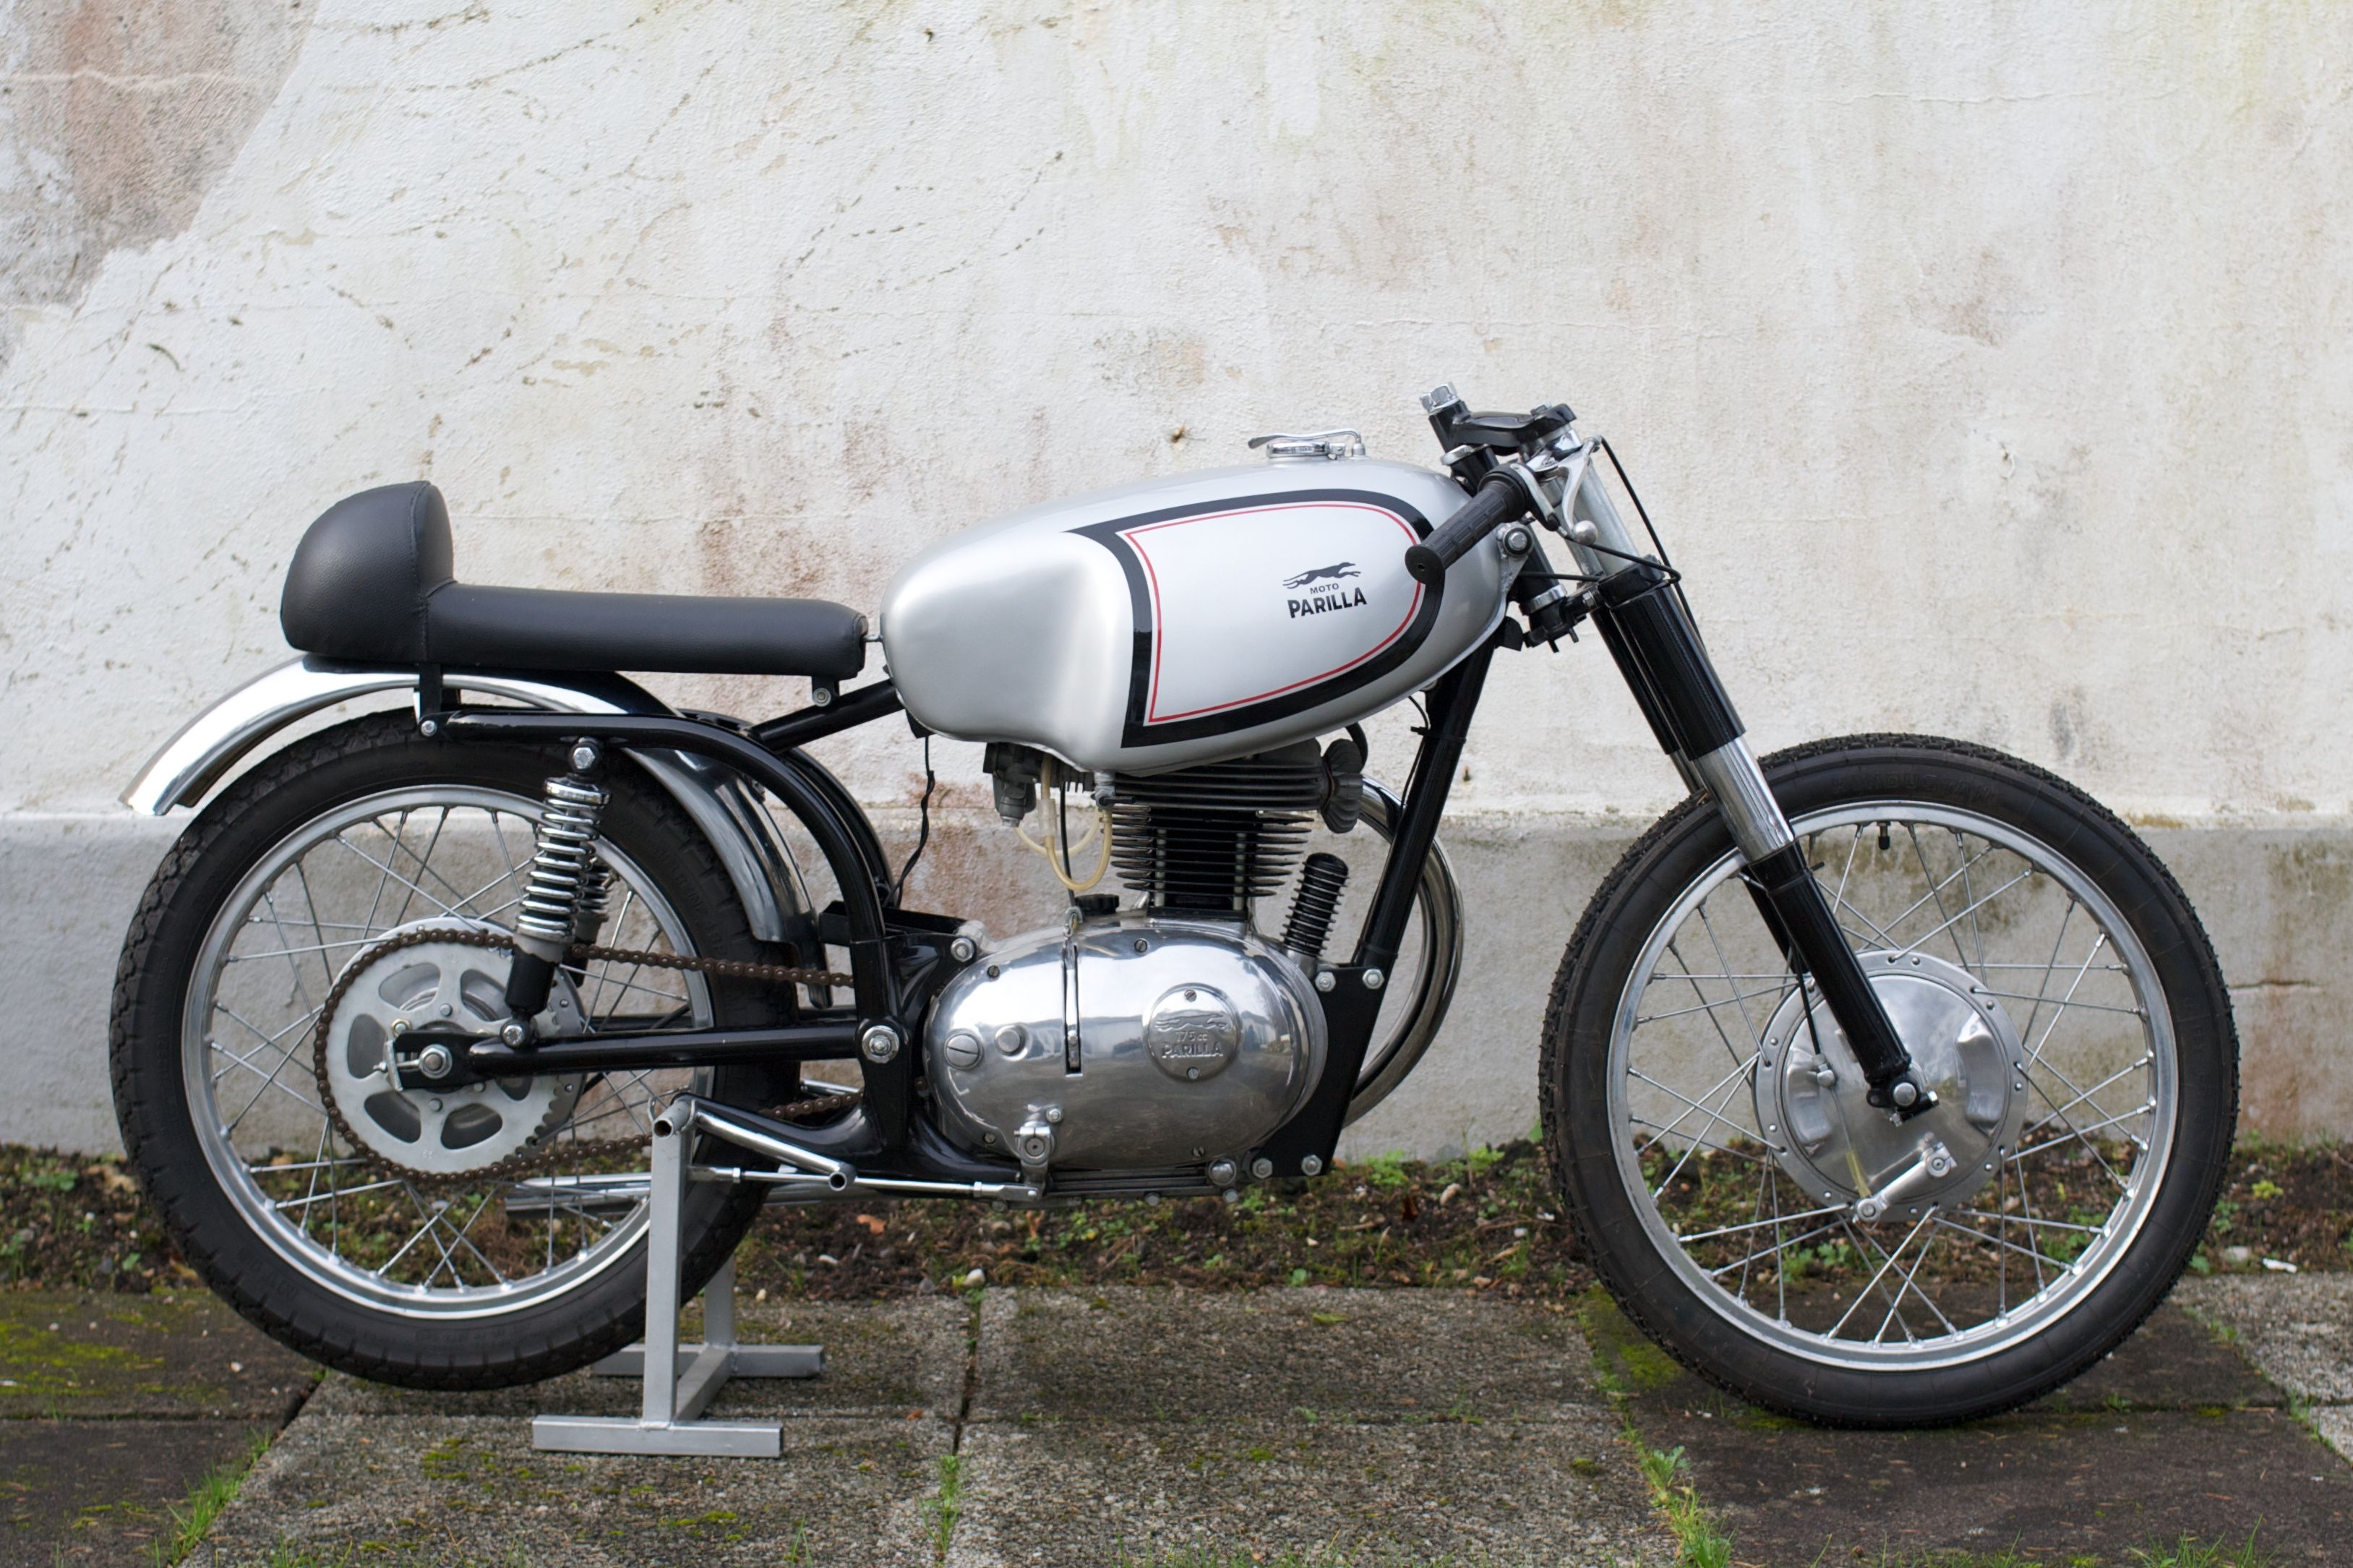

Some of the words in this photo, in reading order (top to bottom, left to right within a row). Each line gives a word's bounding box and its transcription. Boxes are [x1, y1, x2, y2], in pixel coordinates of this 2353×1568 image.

[1310, 583, 1340, 594] MOTO
[1287, 587, 1367, 619] PARILLA
[1176, 1031, 1195, 1042] 175
[1162, 1041, 1223, 1058] PARILLA
